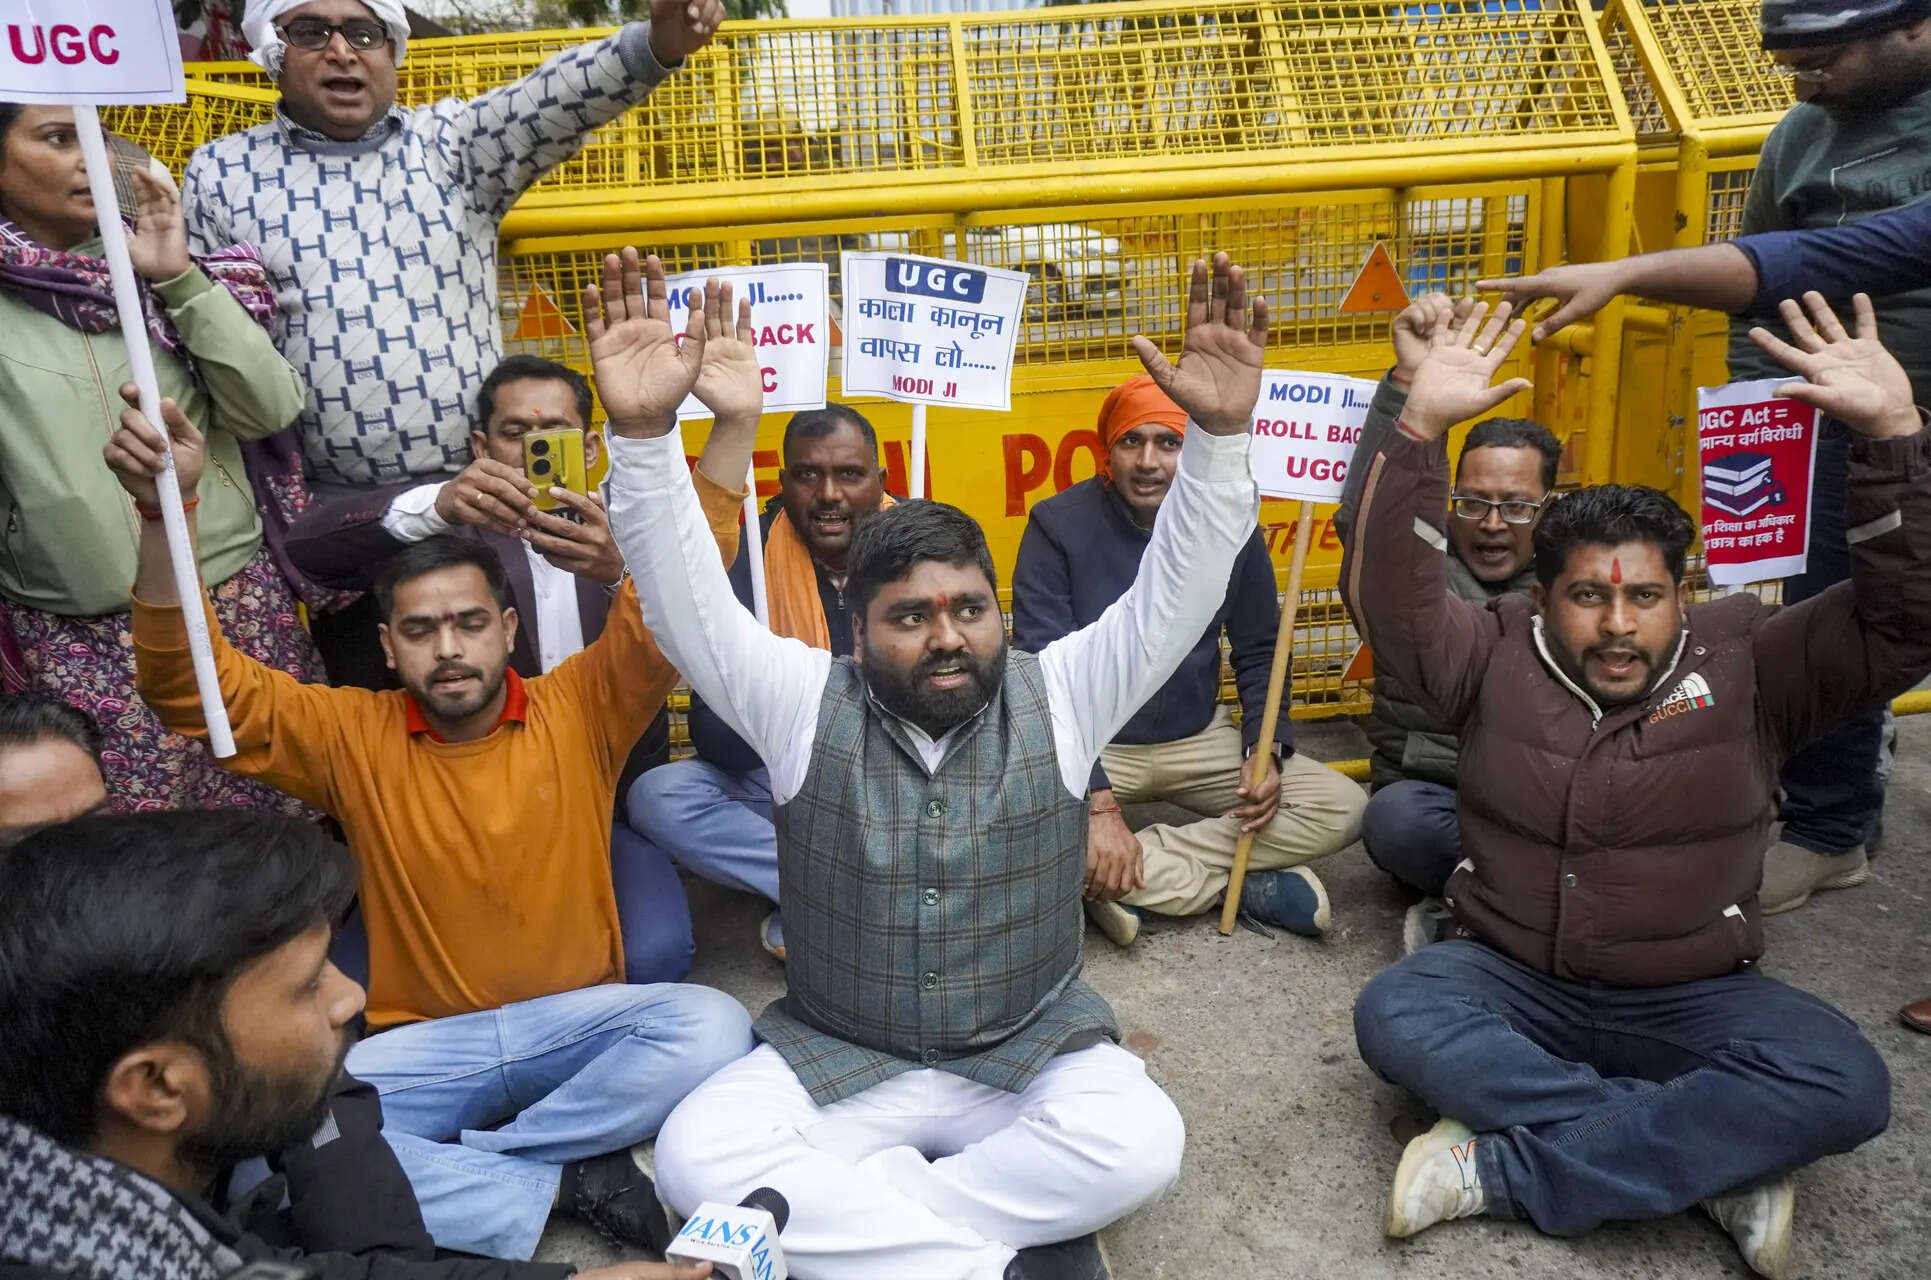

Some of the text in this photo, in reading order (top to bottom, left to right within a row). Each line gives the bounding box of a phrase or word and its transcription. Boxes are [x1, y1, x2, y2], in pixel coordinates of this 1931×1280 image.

[8, 24, 119, 65] UGC
[899, 263, 971, 295] UGC
[859, 298, 1005, 340] काला कानून
[857, 337, 922, 363] वापस
[892, 375, 958, 398] MODI JI
[1269, 383, 1332, 405] MODI
[1740, 406, 1770, 427] Act
[1255, 418, 1362, 445] ROLL BAC
[1760, 423, 1804, 444] विरोधी
[1286, 456, 1347, 483] UGC
[1649, 699, 1692, 724] GUCCI
[681, 1216, 758, 1245] IANS
